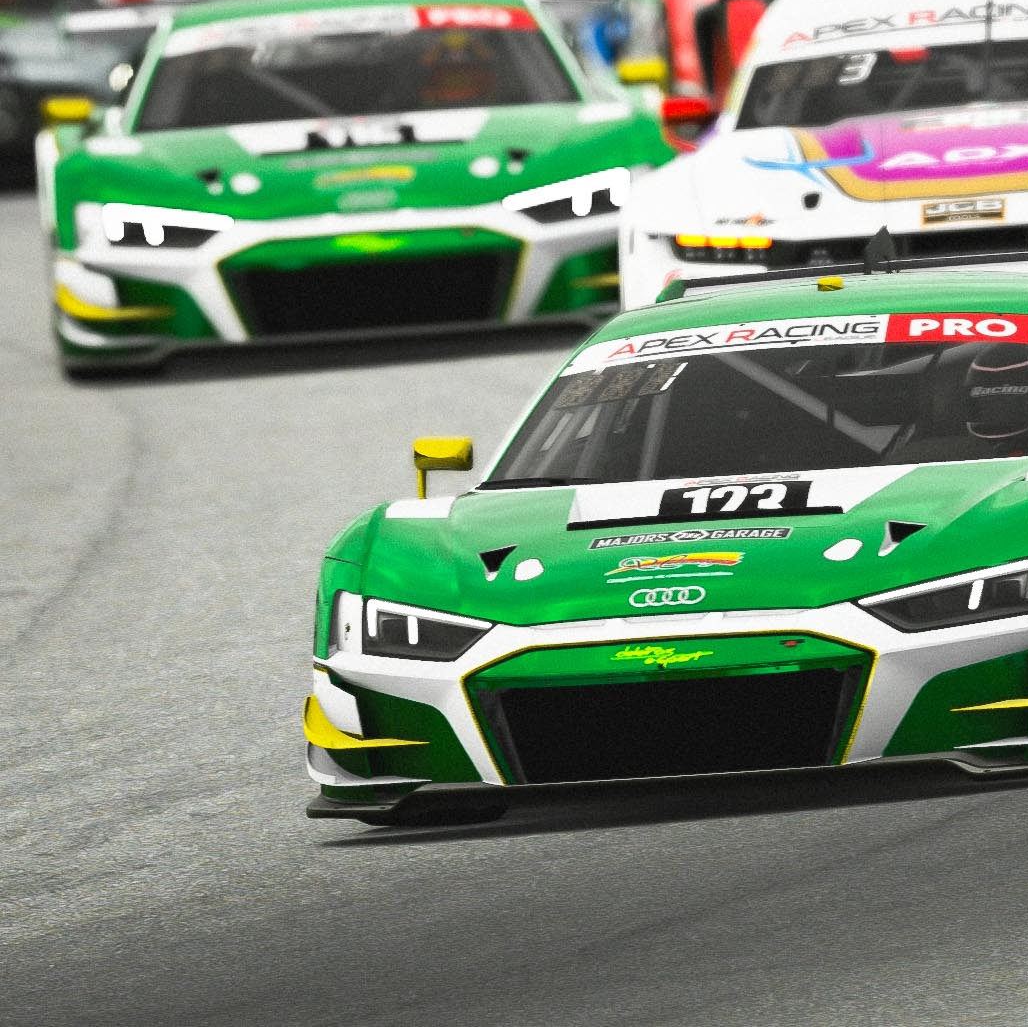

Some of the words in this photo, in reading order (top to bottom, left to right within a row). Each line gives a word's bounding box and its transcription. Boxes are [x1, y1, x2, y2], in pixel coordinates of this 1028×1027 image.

[782, 14, 897, 51] APEX
[607, 334, 724, 359] APEX
[725, 321, 881, 343] RACING
[909, 317, 1018, 338] PRO
[682, 483, 788, 514] 123
[596, 533, 669, 548] MAJORS
[710, 528, 785, 540] GARAGE
